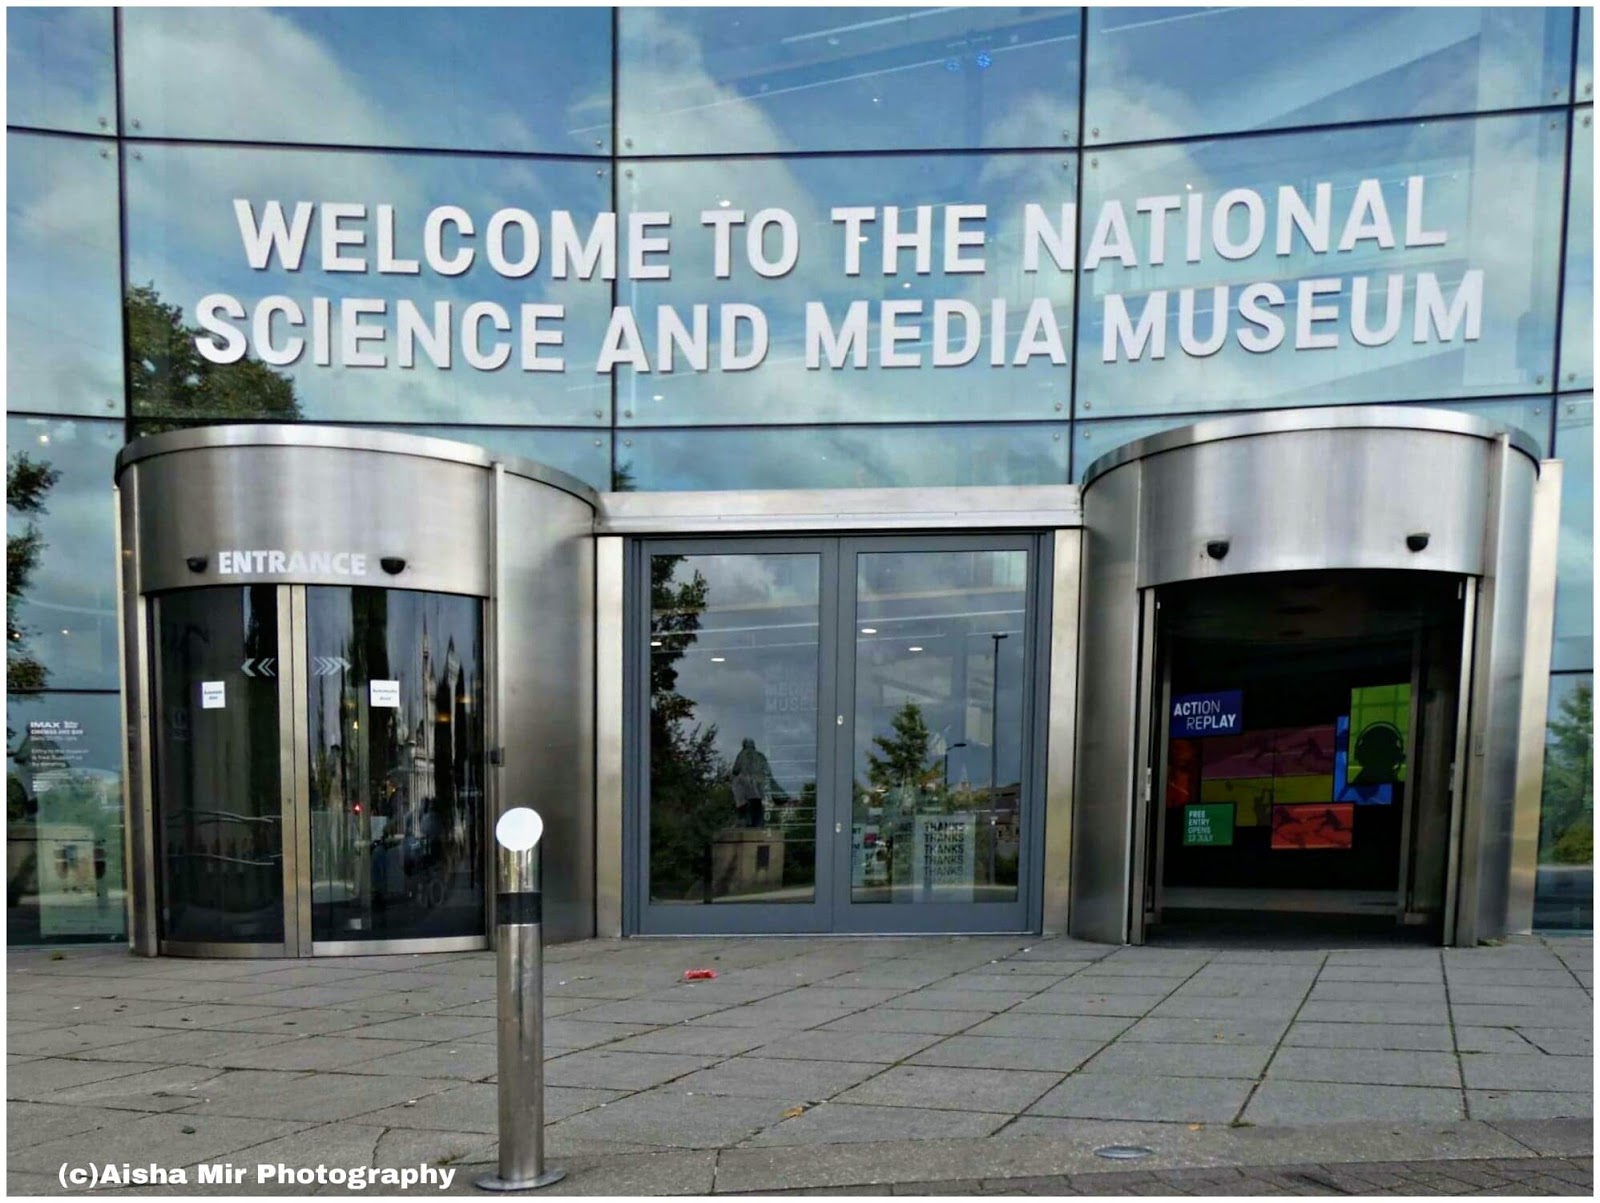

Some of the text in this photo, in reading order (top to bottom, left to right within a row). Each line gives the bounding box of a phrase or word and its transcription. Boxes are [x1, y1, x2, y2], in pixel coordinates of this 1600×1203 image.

[232, 174, 1448, 280] WELCOME TO THE NATIONAL
[195, 268, 1485, 373] SCIENCE AND MEDIA MUSEUM
[218, 550, 367, 576] ENTRANCE
[1173, 699, 1221, 717] ACTION
[1186, 713, 1237, 730] REPLAY
[1188, 810, 1206, 818] FREE
[1188, 818, 1210, 826] ENTRY
[1188, 826, 1211, 834] OPENS
[924, 833, 965, 843] THANKS
[924, 844, 965, 854] THANKS
[924, 855, 965, 865] THANKS
